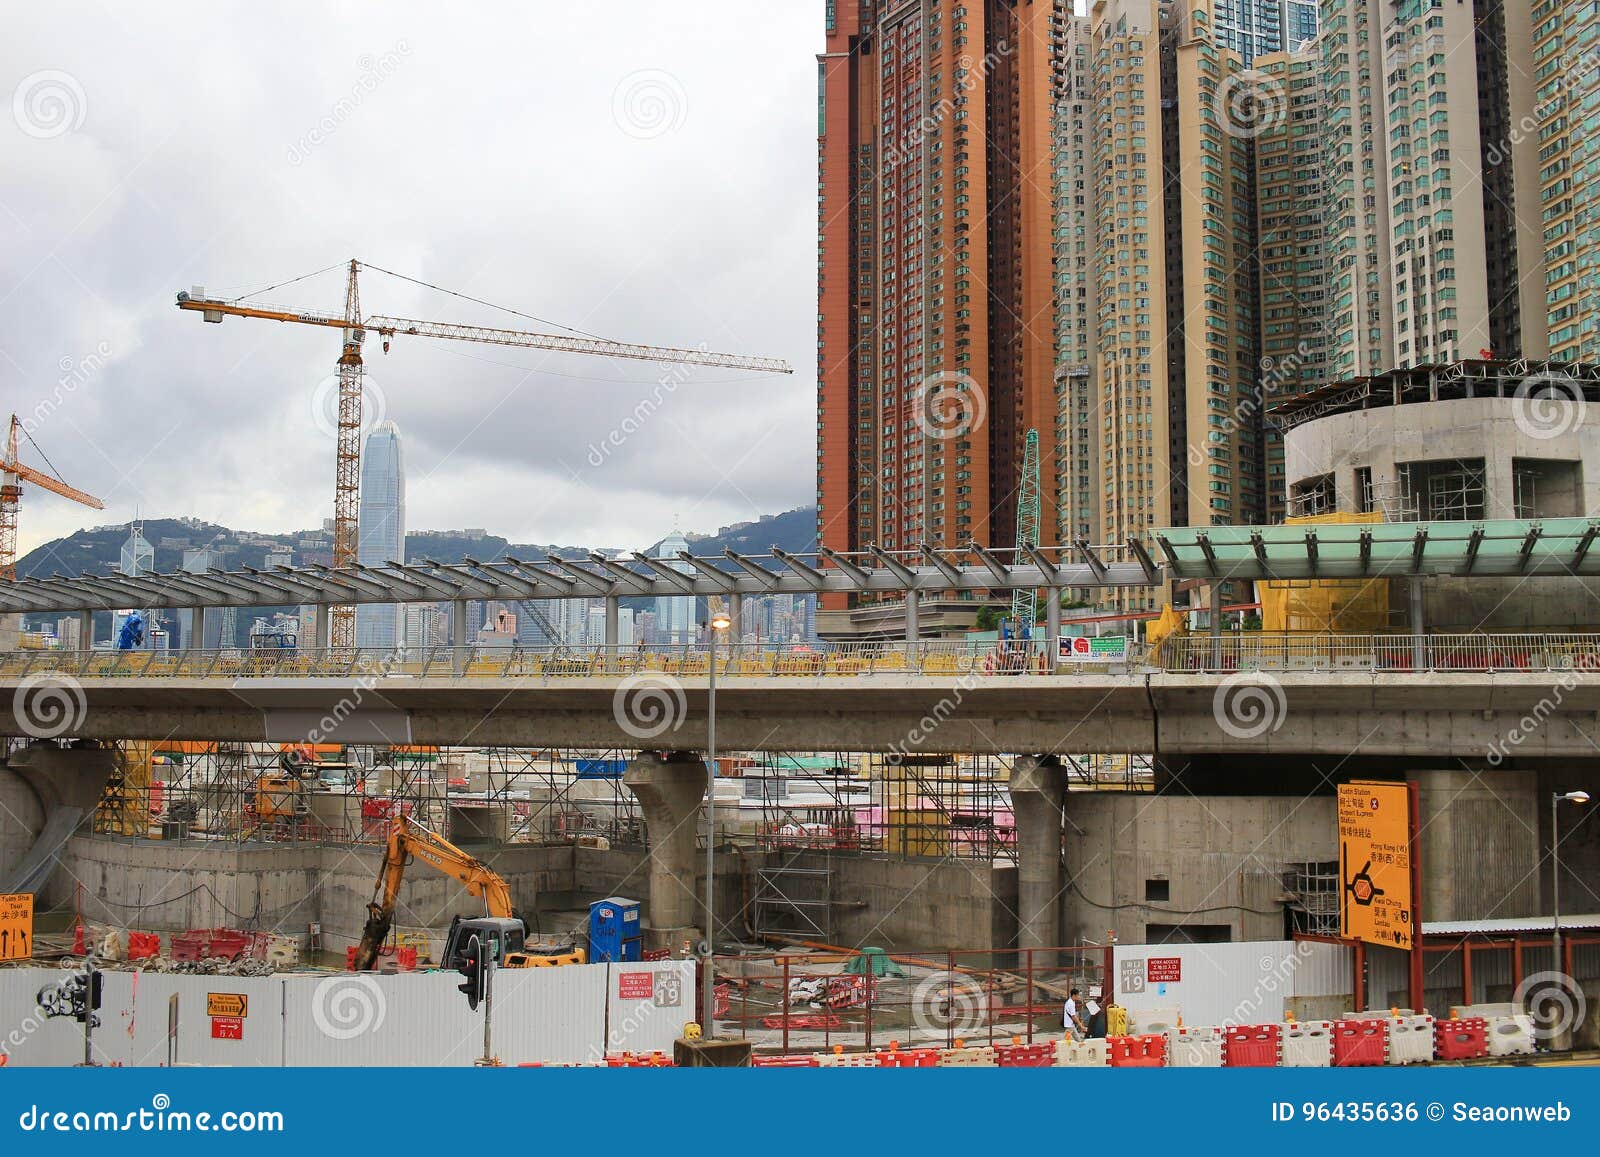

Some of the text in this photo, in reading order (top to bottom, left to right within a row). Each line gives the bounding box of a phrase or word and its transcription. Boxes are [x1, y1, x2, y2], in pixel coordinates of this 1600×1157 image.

[1353, 788, 1371, 796] Station
[1123, 975, 1143, 991] 19
[656, 989, 679, 1005] 19
